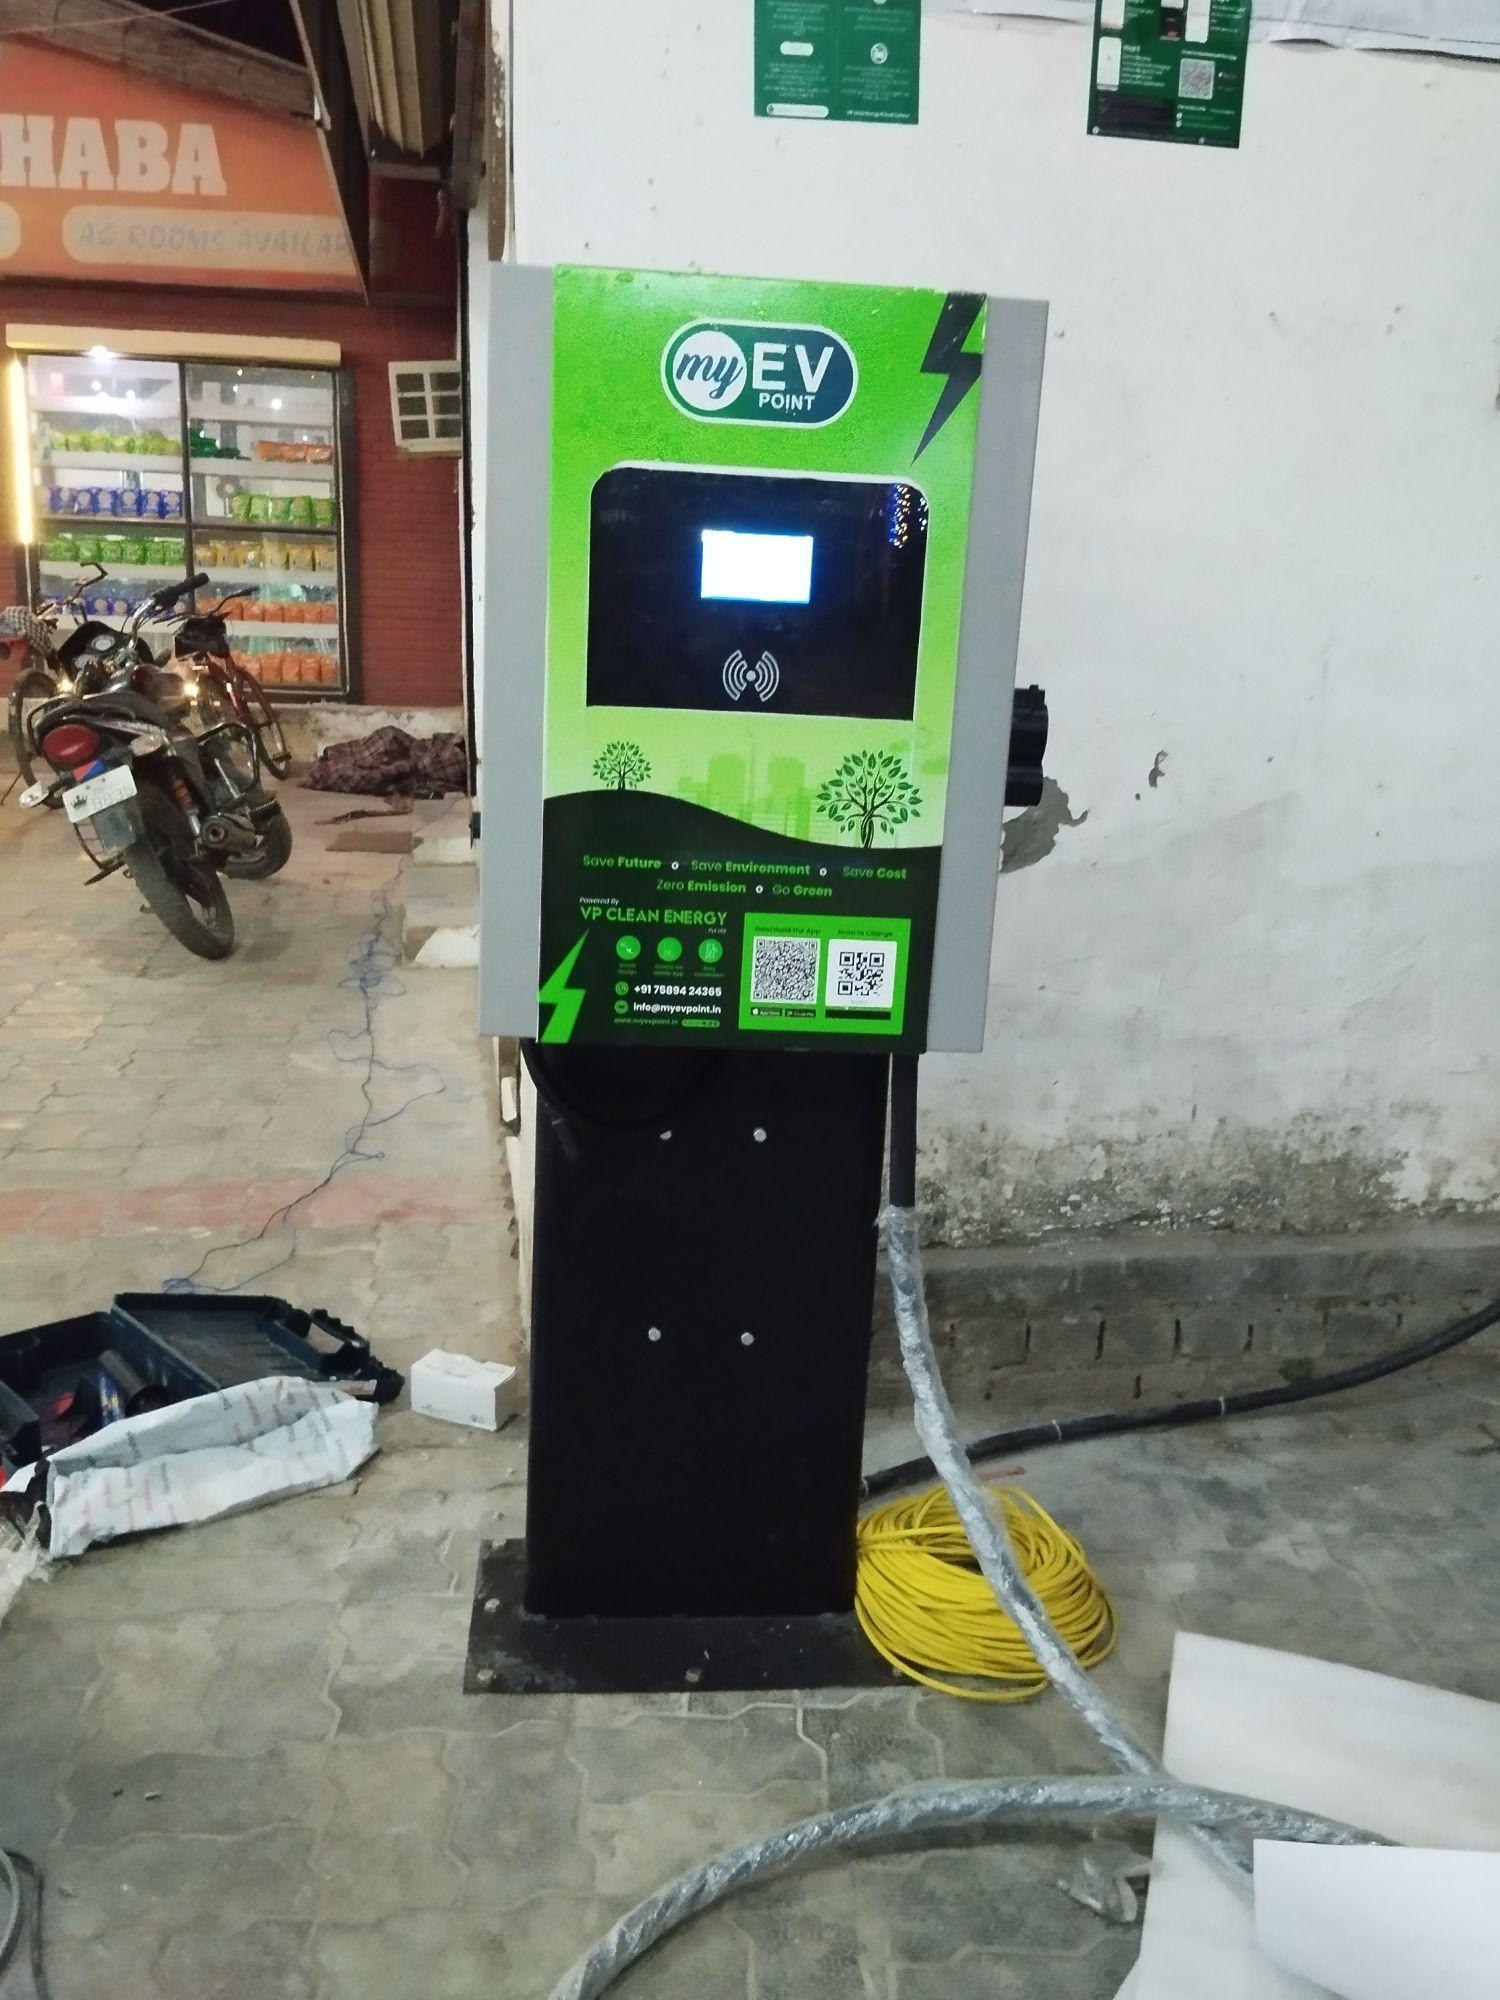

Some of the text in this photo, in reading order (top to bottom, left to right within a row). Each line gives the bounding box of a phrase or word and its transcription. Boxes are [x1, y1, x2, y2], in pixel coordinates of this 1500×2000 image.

[676, 341, 834, 399] my EV
[759, 392, 815, 411] POINT
[583, 855, 661, 869] Save Future
[691, 860, 810, 876] Save Environment
[843, 866, 907, 880] Save Cost
[656, 879, 746, 893] Zero Emission
[773, 884, 832, 897] Go Green
[579, 897, 620, 906] Powered By
[580, 906, 727, 926] VP CLEAN ENERGY
